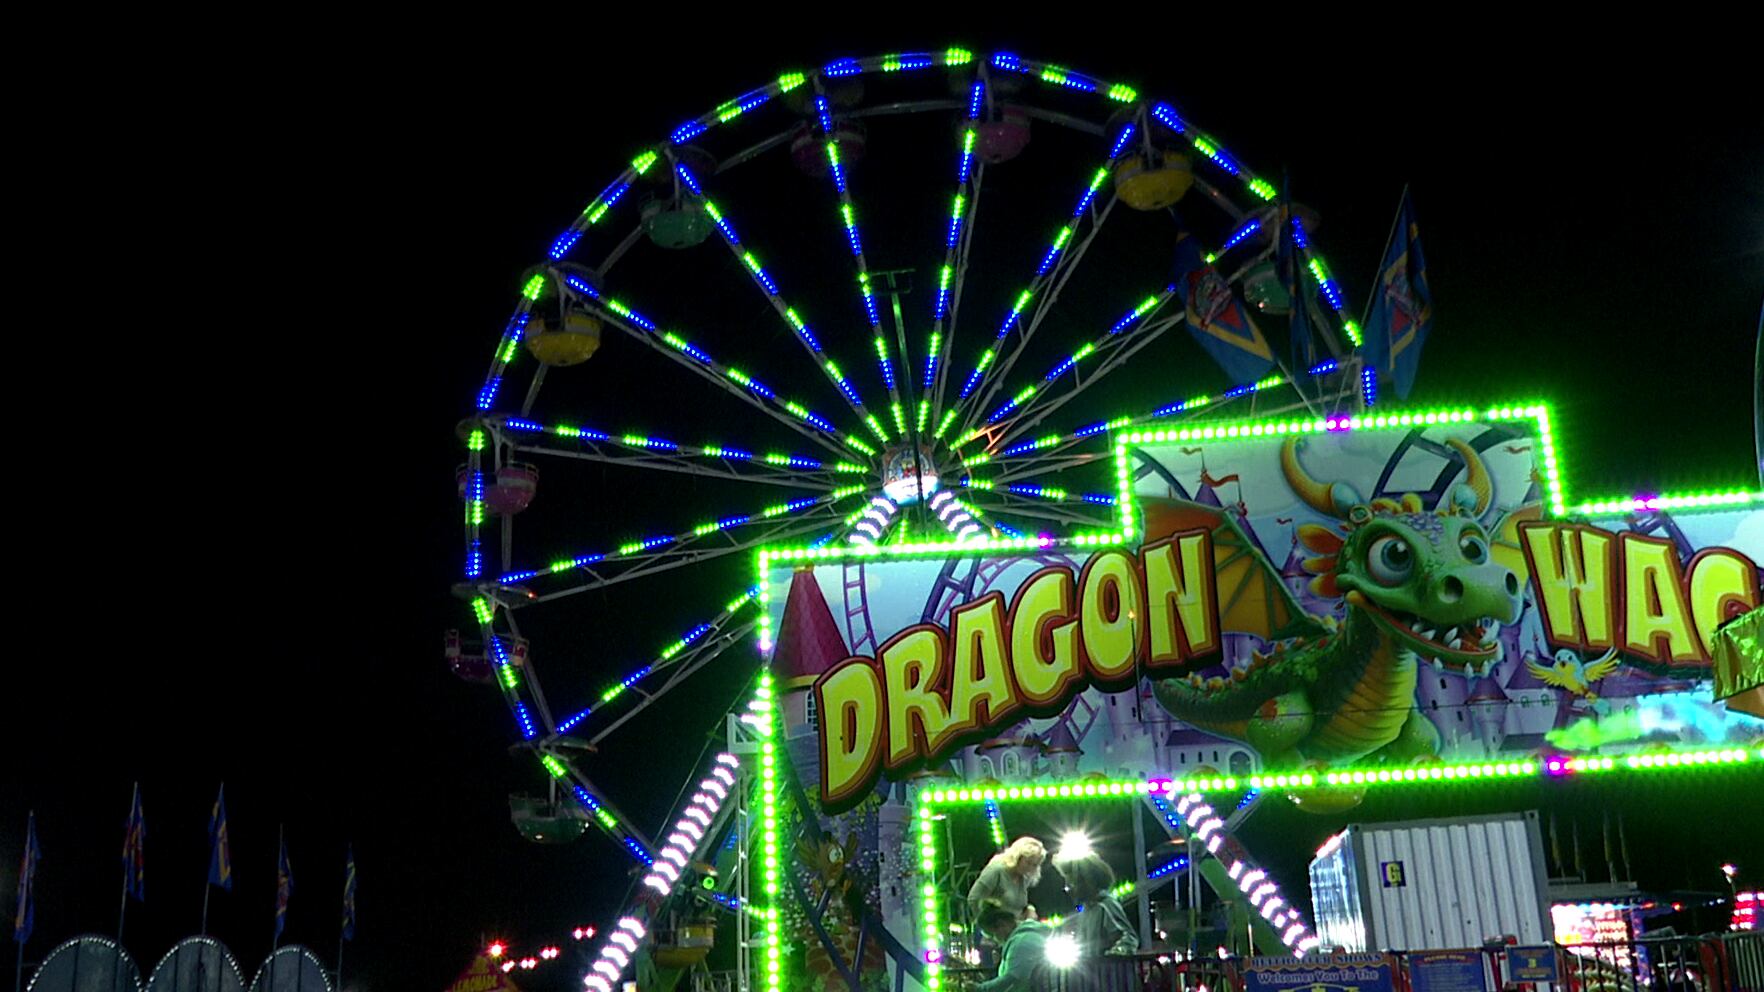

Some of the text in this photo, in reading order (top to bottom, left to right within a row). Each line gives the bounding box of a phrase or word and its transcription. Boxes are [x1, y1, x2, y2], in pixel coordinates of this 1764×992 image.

[816, 530, 1220, 808] DRAGON
[1337, 954, 1382, 964] SHOWS
[1257, 969, 1379, 984] Welcomes You To The
